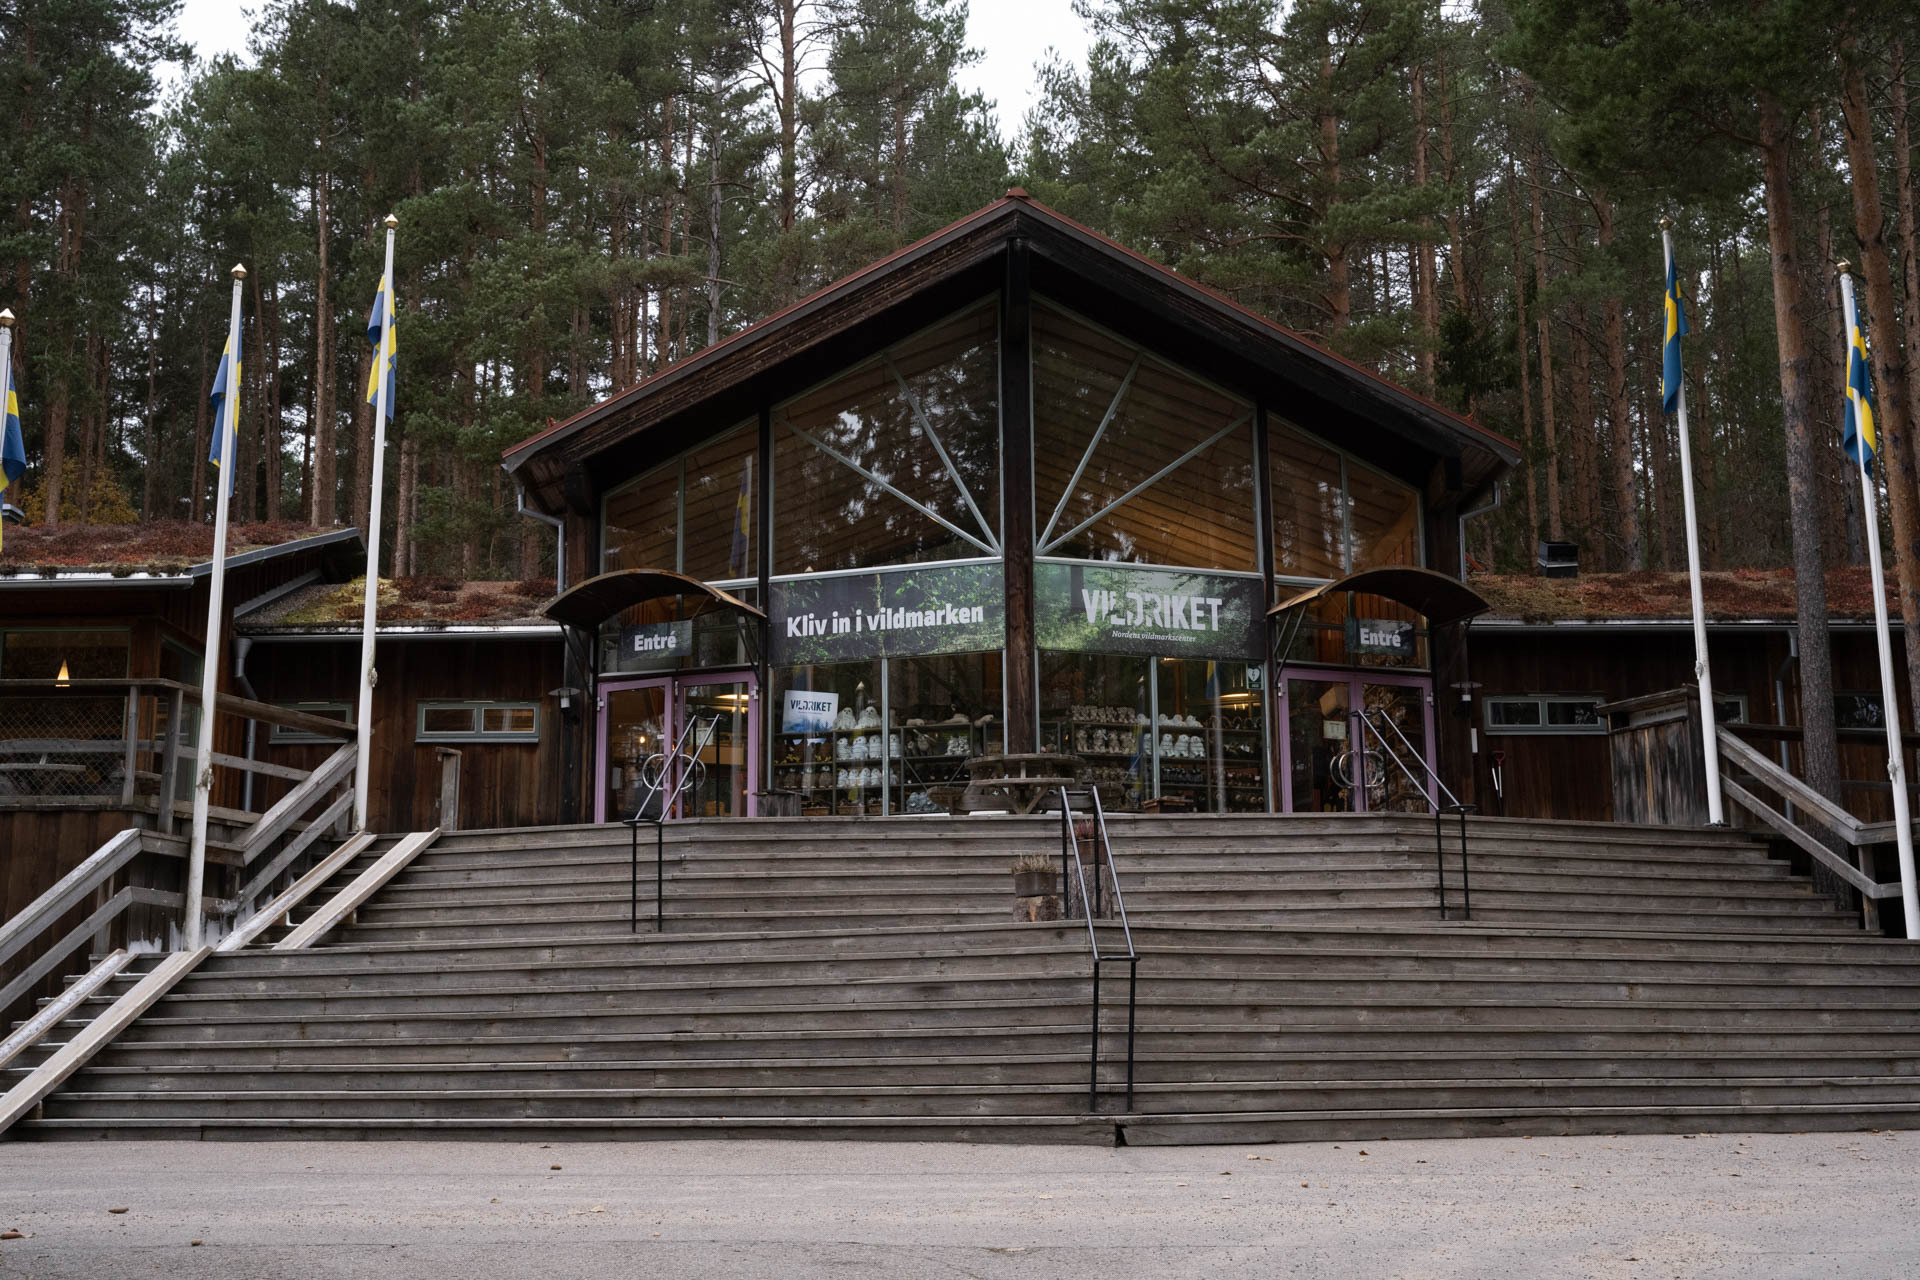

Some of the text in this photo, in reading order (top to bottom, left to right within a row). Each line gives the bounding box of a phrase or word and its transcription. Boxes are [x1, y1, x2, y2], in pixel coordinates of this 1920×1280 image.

[787, 603, 984, 637] Kliv in i vildmarken
[1082, 589, 1222, 631] VILDRIKET
[634, 630, 677, 651] Entré
[1112, 630, 1196, 642] Nordens vildmarkscenter
[1360, 628, 1401, 647] Entré
[790, 699, 832, 712] VILDRIKET
